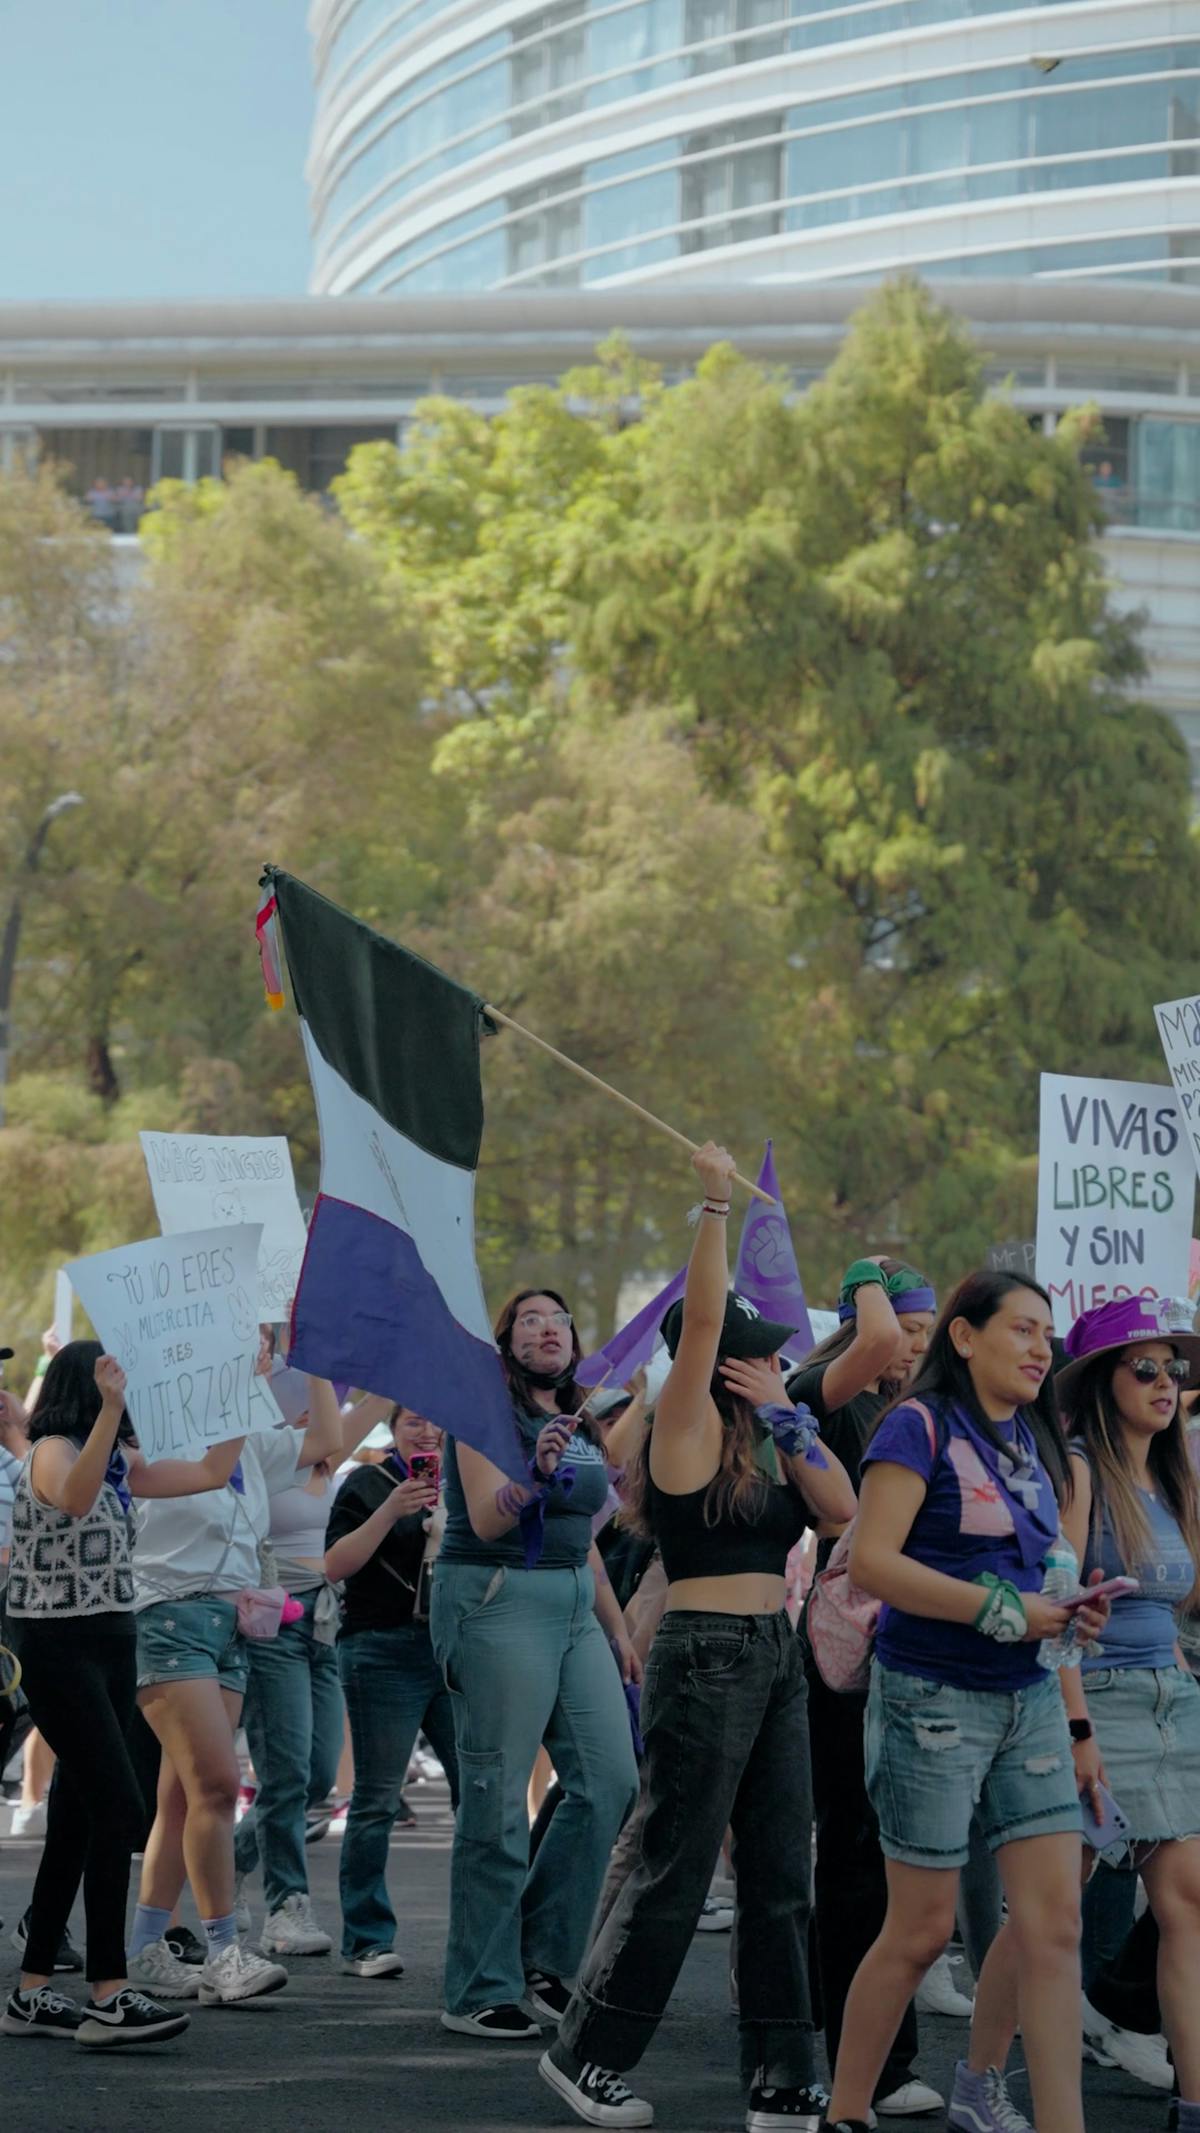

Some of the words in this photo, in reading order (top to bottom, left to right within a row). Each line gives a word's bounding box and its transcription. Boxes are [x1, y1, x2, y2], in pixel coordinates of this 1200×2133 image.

[1060, 1092, 1178, 1157] VIVAS
[1053, 1161, 1174, 1213] LIBRES
[182, 1246, 236, 1294] ERES
[1059, 1225, 1080, 1267] Y
[1089, 1225, 1144, 1266] SIN
[162, 1342, 194, 1368] ERES
